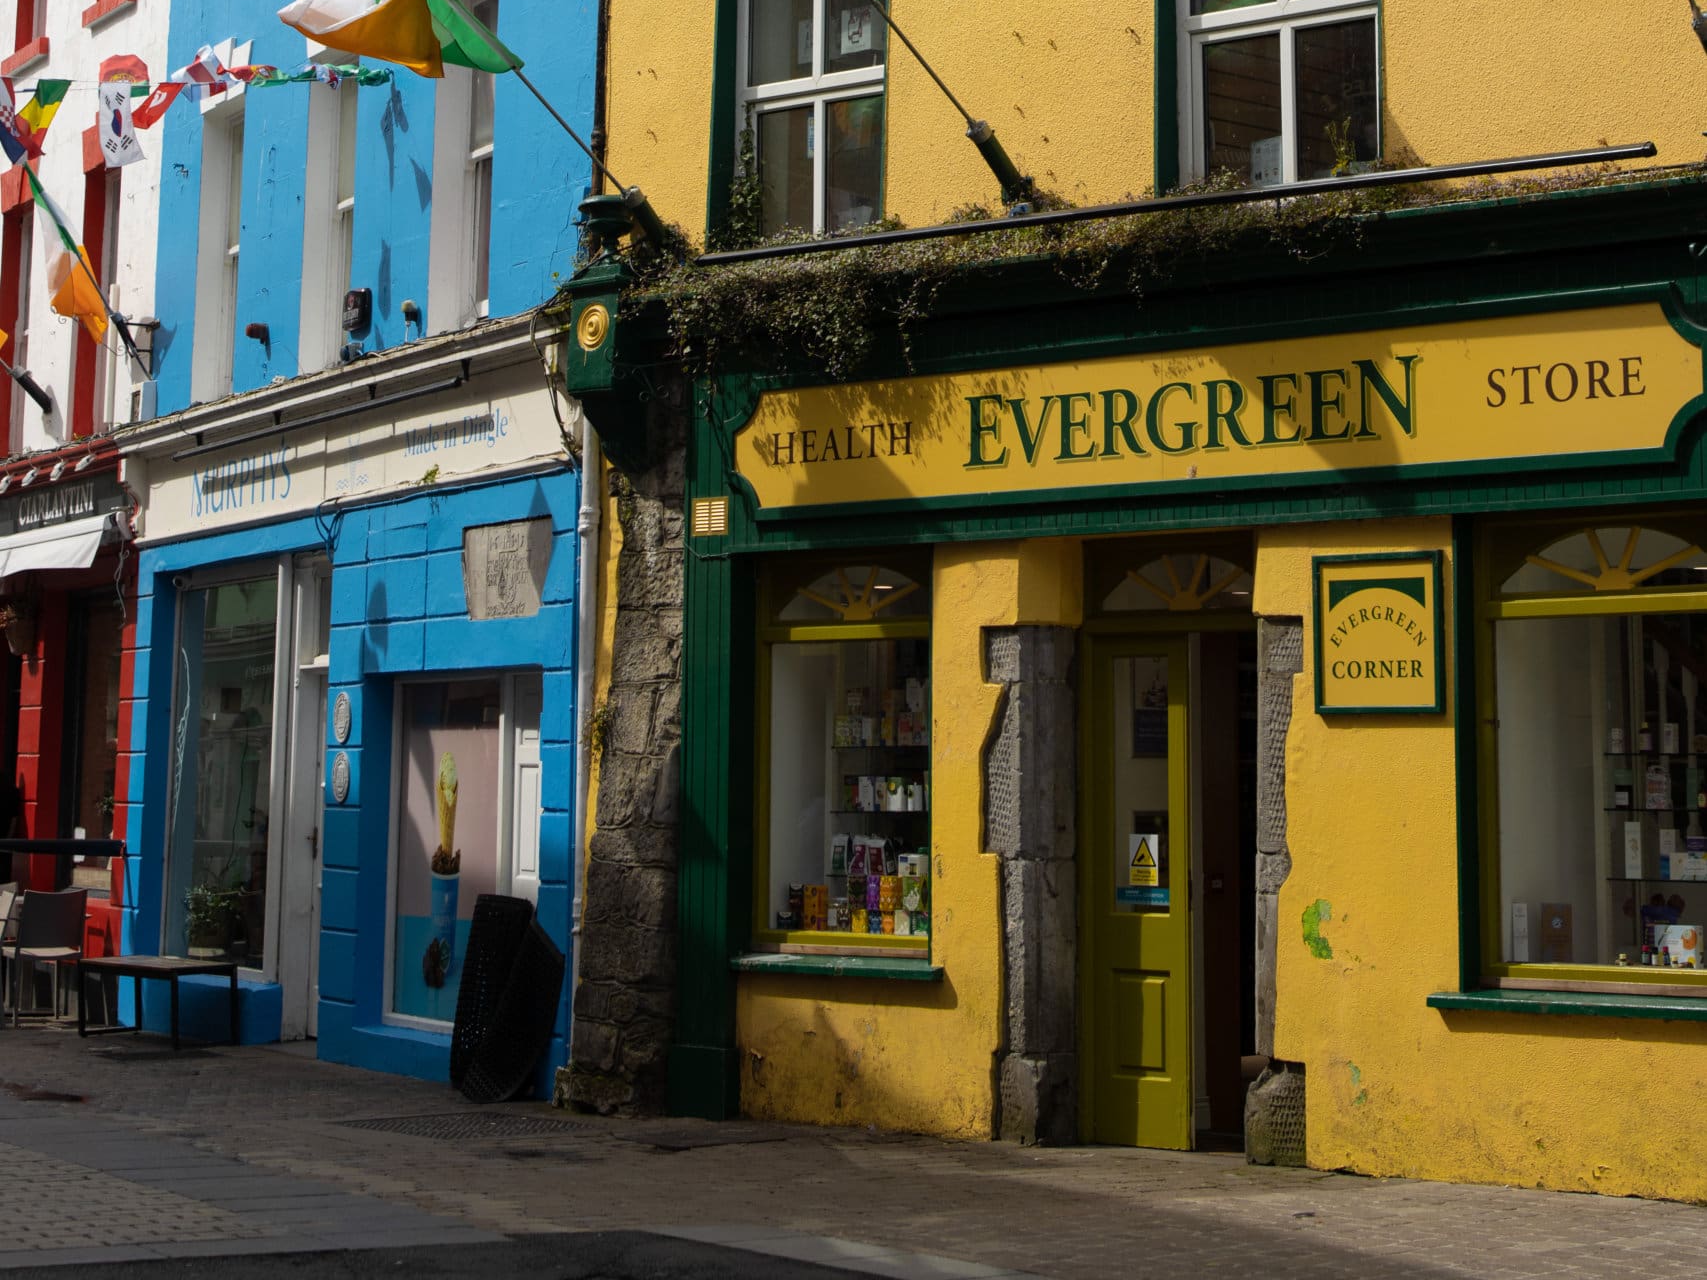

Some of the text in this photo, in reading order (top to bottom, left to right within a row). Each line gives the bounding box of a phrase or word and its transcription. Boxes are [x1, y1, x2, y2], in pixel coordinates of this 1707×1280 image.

[403, 408, 509, 458] Made in Dingle
[772, 354, 1647, 470] HEALTH EVERGREEN STORE
[18, 483, 94, 526] CIARLANTINI
[1330, 605, 1427, 648] EVERGREEN
[1332, 659, 1424, 680] CORNER
